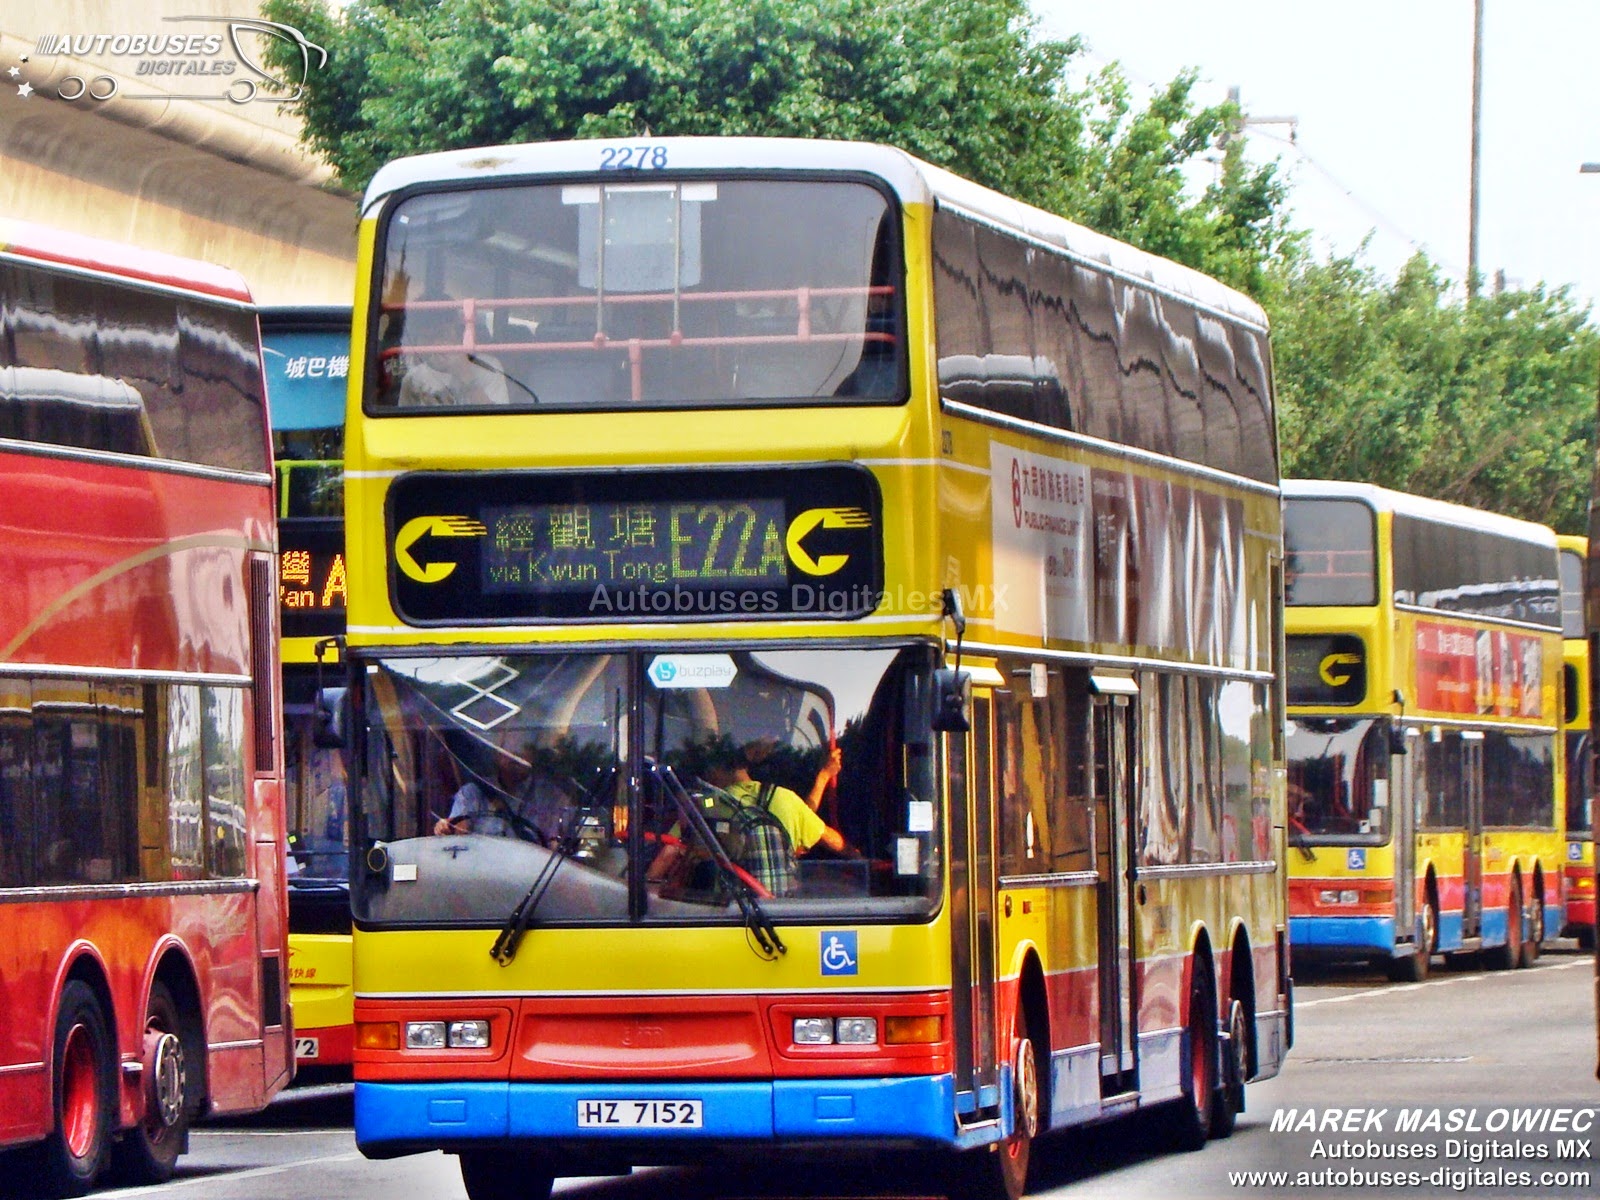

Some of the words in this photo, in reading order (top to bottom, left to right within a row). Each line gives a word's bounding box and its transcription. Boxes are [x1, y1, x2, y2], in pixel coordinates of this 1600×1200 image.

[600, 146, 667, 169] 2278
[671, 504, 787, 578] E22A
[490, 566, 520, 581] via
[529, 551, 597, 582] Kwun
[603, 550, 667, 583] Tong
[679, 665, 732, 678] buzplay
[586, 1102, 620, 1123] HZ
[634, 1102, 695, 1124] 7152
